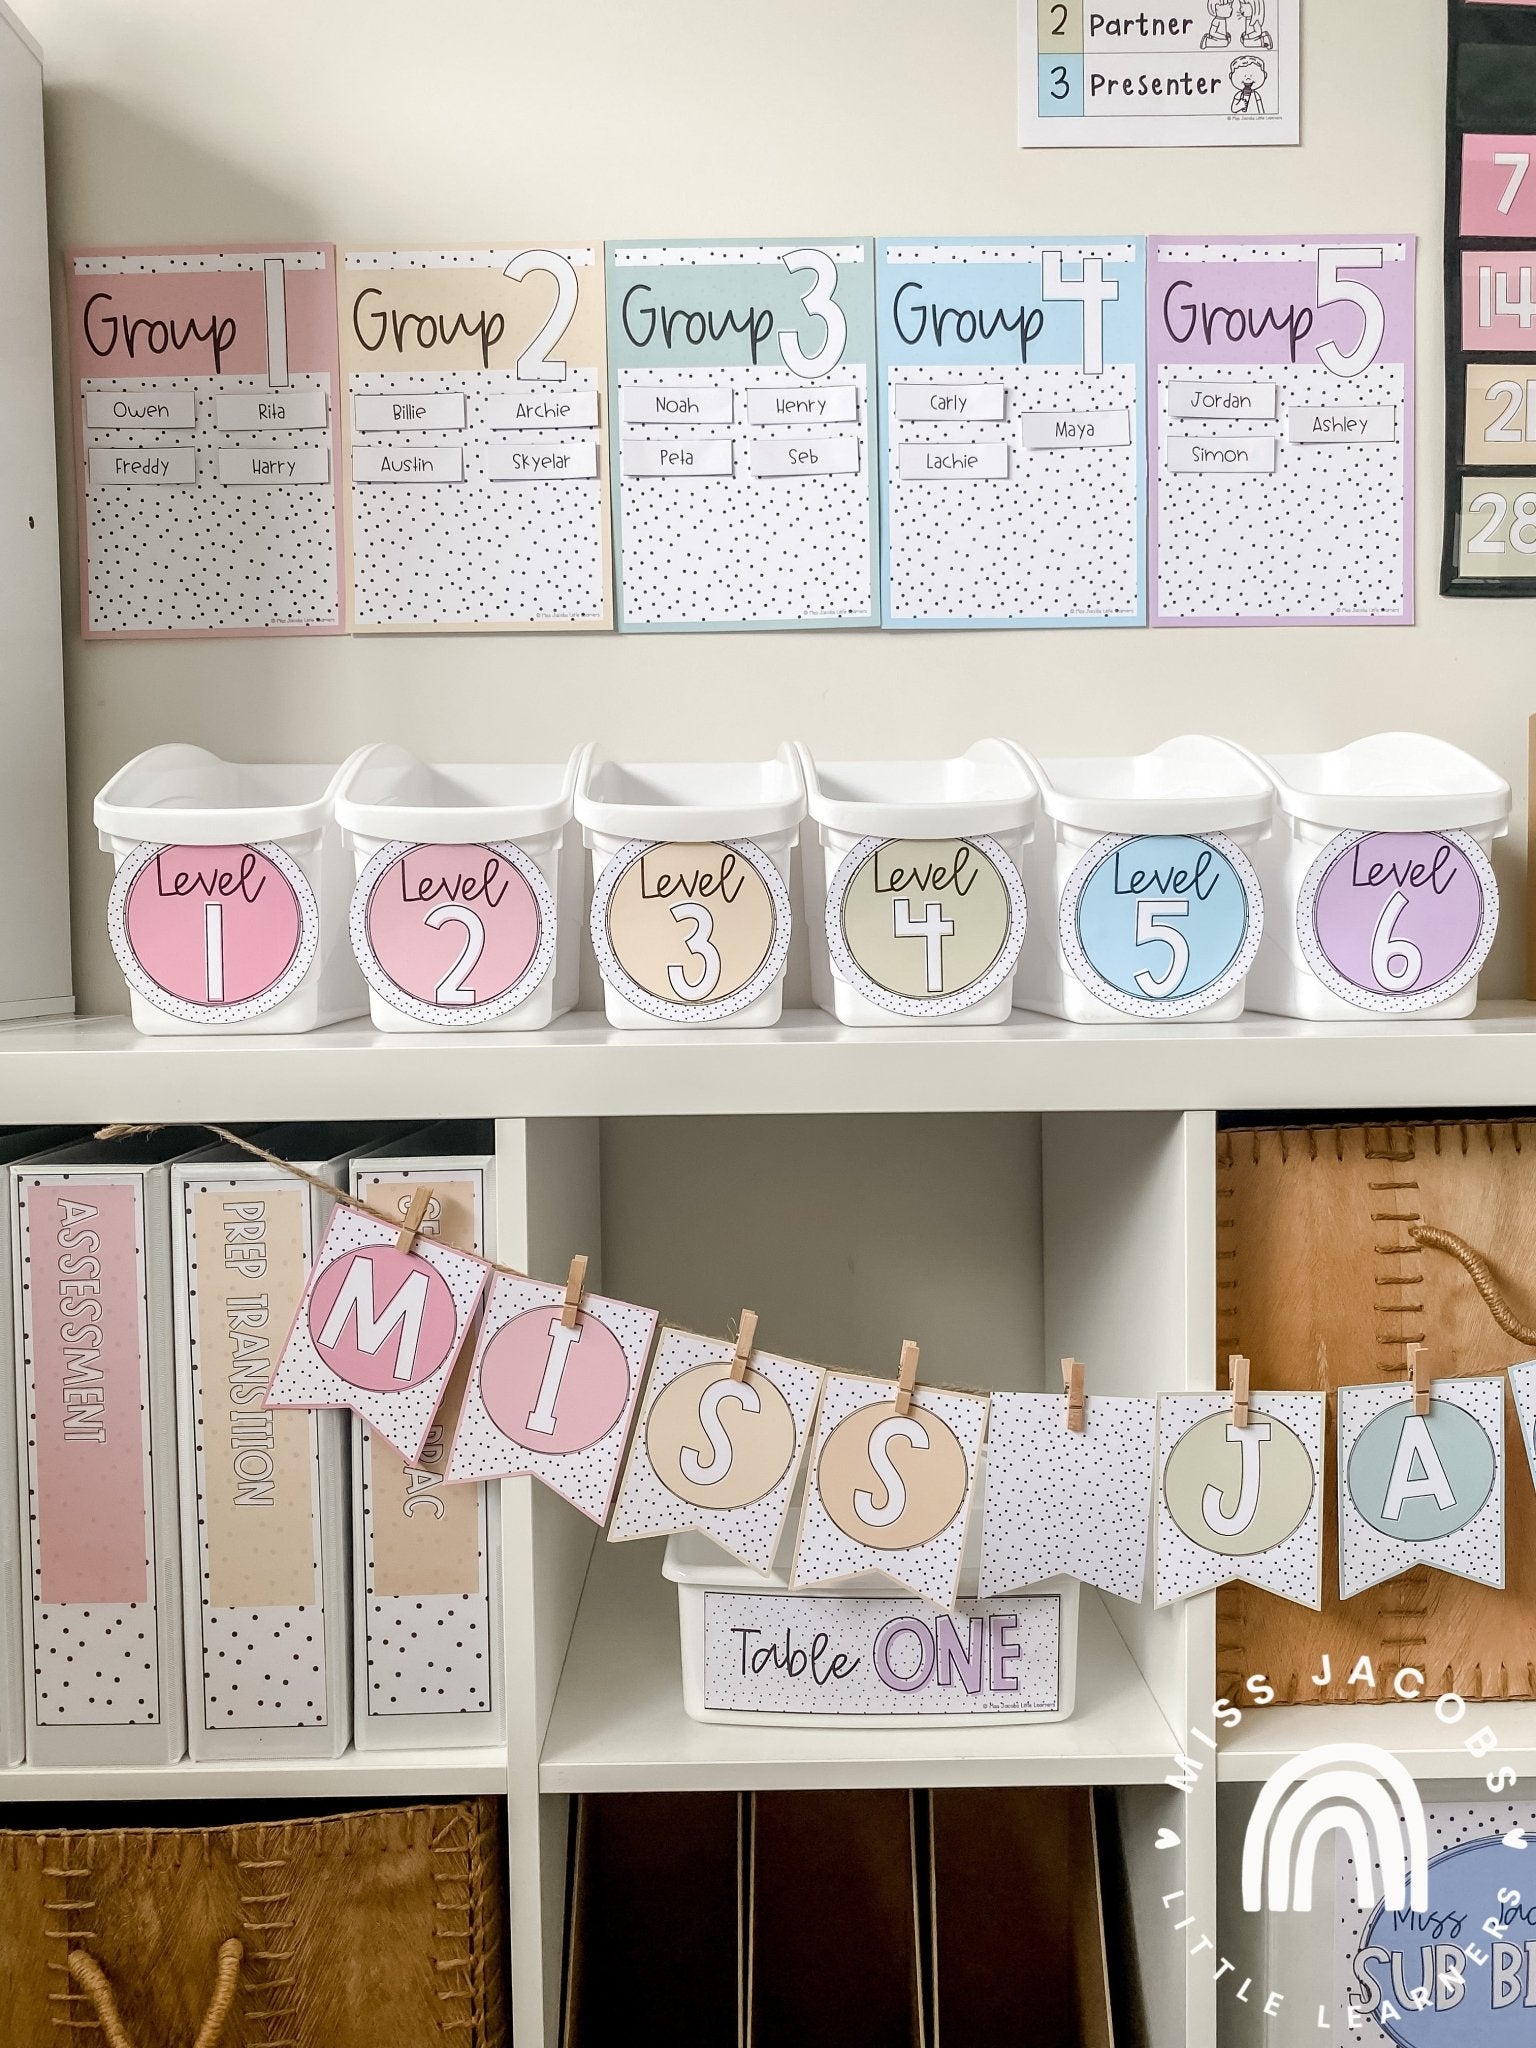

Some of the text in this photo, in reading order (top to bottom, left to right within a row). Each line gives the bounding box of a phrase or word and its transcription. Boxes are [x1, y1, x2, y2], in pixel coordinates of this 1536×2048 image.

[1050, 3, 1193, 37] 2 Partner
[1050, 65, 1221, 100] 3 Presenter
[1494, 152, 1530, 216] 7
[83, 258, 289, 387] Group 1
[353, 249, 578, 381] Group 2
[622, 248, 847, 378] Group 3
[893, 250, 1119, 374] Group 4
[1163, 248, 1385, 377] Group 5
[113, 401, 169, 419] Owen
[258, 403, 285, 421] Rita
[392, 403, 426, 421] Billie
[515, 401, 571, 419] Archie
[656, 396, 699, 413] Noah
[776, 397, 827, 416] Henry
[930, 394, 967, 412] Carly
[1191, 390, 1251, 410] Jordan
[1312, 415, 1368, 434] Ashley
[1055, 420, 1095, 438] Maya
[115, 457, 170, 477] Freddy
[252, 457, 296, 477] Harry
[381, 456, 434, 473] Austin
[512, 451, 571, 472] Skyelar
[660, 448, 694, 466] Peta
[788, 447, 819, 465] Seb
[926, 451, 978, 470] Lachie
[1192, 446, 1249, 464] Simon
[1467, 492, 1536, 553] 28
[157, 853, 266, 902] Level
[401, 858, 509, 907] Level
[641, 854, 743, 903] Level
[873, 847, 977, 896] Level
[1113, 851, 1219, 900] Level
[1352, 844, 1456, 896] Level
[205, 903, 224, 1002] 1
[423, 902, 487, 1005] 2
[667, 903, 722, 1001] 3
[893, 898, 954, 993] 4
[1133, 900, 1190, 998] 5
[1369, 890, 1423, 993] 6
[57, 1198, 107, 1444] ASSESSMENT
[222, 1201, 275, 1506] PREP TRANSITION
[730, 1613, 1022, 1694] Table ONE
[1393, 1906, 1468, 1939] Miss
[1348, 1943, 1467, 2014] SUB
